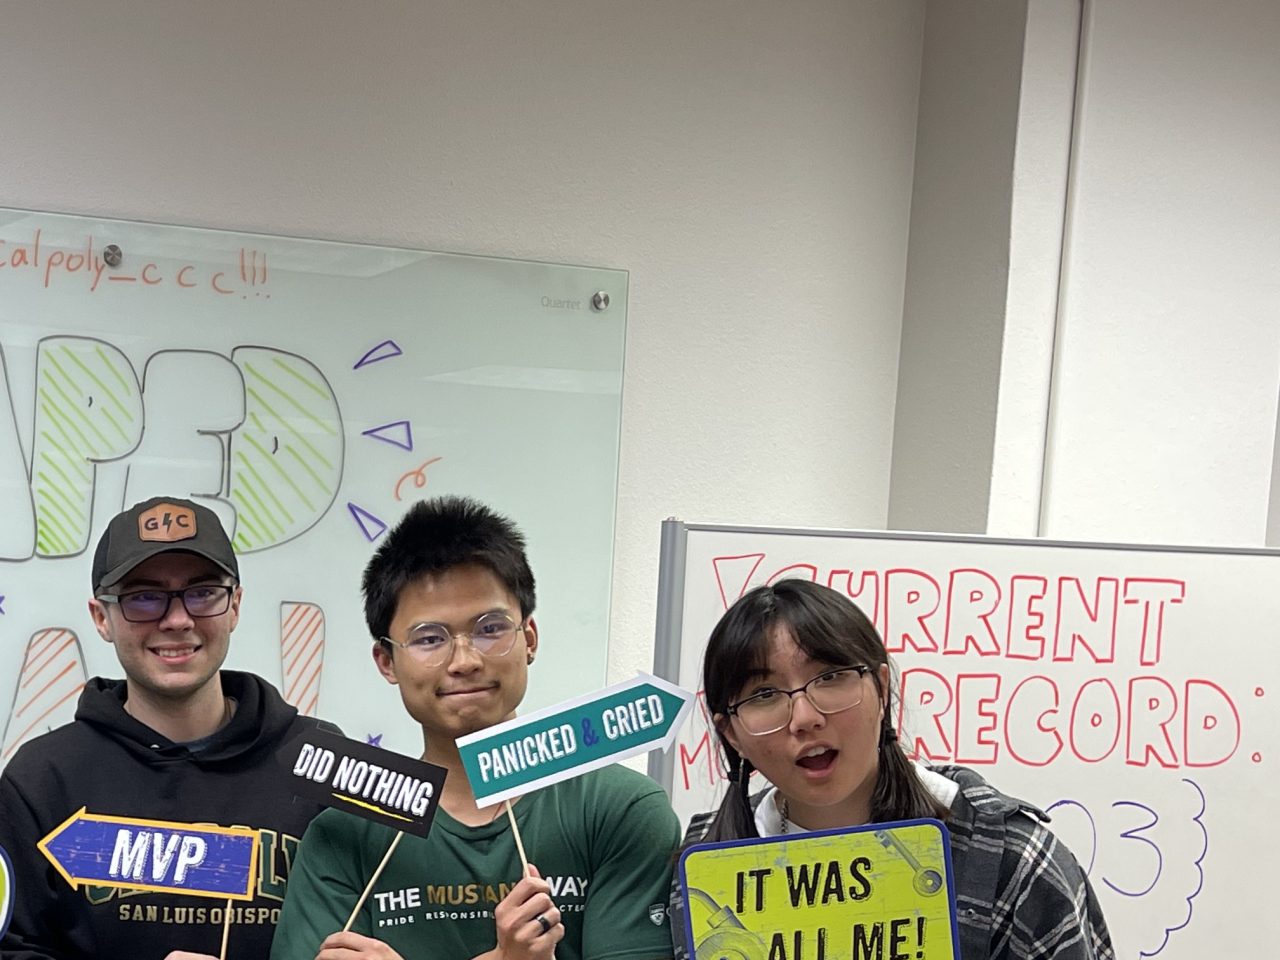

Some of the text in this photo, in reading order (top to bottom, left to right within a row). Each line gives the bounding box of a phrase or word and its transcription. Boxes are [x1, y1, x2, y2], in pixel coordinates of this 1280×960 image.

[477, 722, 578, 784] PANICKED
[582, 717, 600, 748] &
[601, 693, 665, 741] CRIED
[894, 666, 1265, 769] RECORD:
[292, 741, 434, 819] DID NOTHING
[108, 828, 208, 885] MVP
[735, 856, 872, 914] IT WAS
[119, 903, 158, 923] SAN
[162, 906, 207, 925] LUIS
[373, 887, 422, 913] THE
[378, 915, 415, 928] PRIDE
